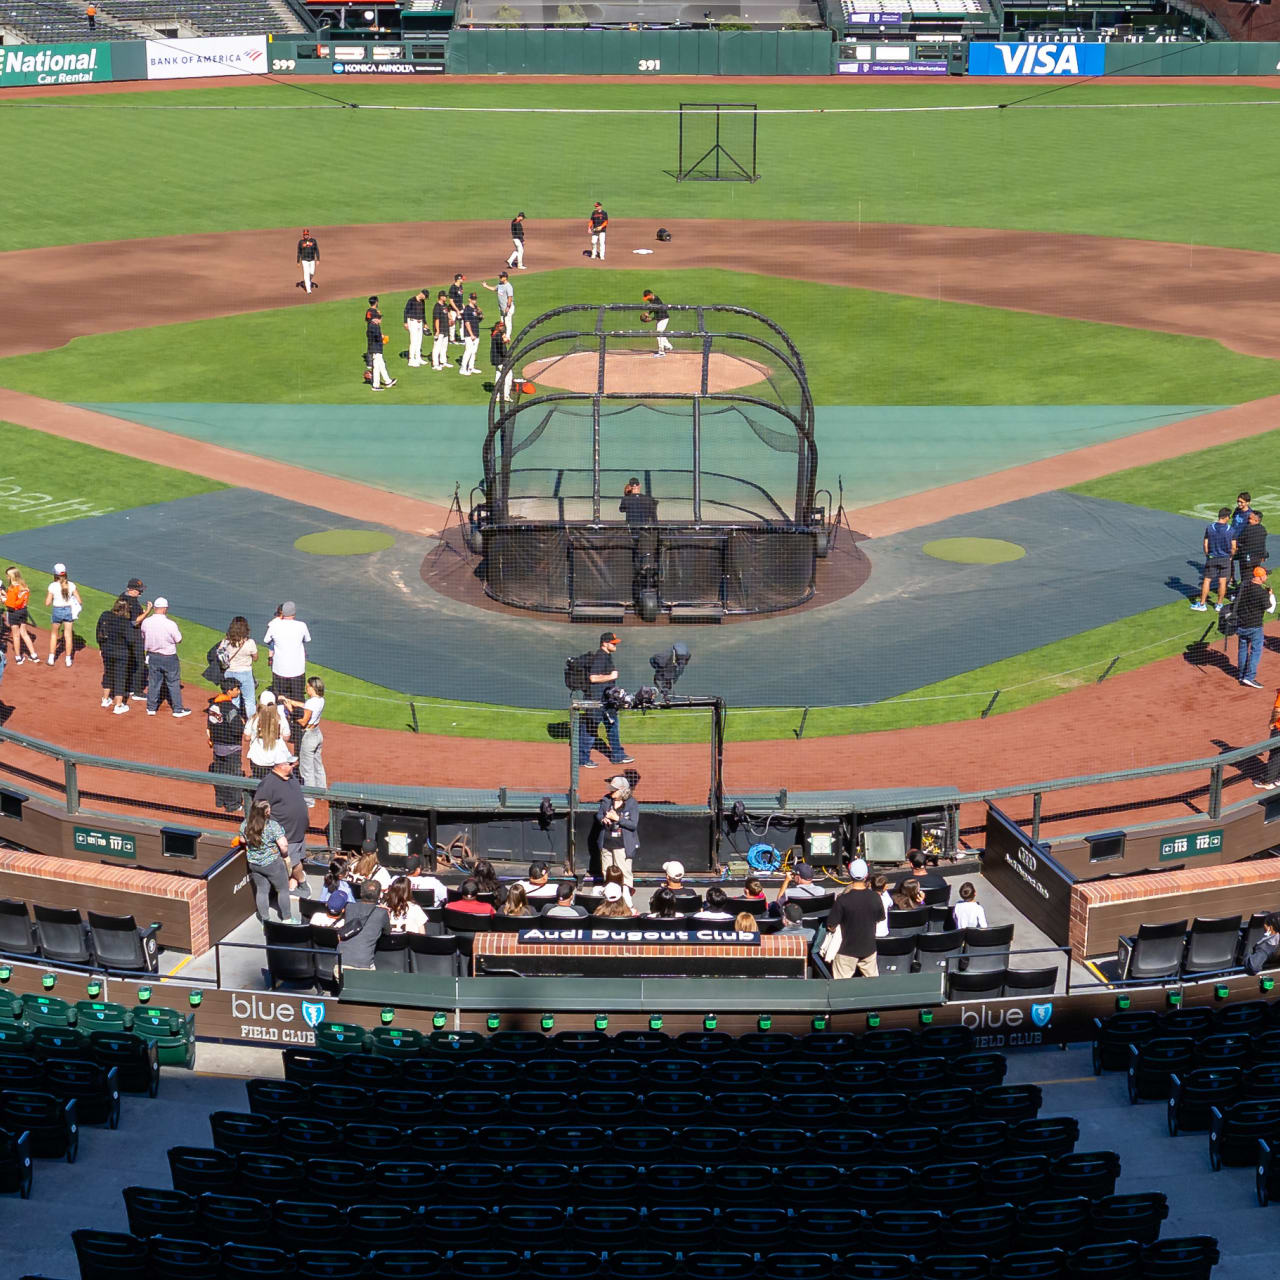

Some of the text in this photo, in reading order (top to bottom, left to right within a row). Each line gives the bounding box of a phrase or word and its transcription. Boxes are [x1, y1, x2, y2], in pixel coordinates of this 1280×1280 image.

[5, 48, 96, 73] National
[150, 54, 242, 66] BANK OF AMERICA
[272, 59, 296, 70] 399
[638, 59, 661, 72] 391
[994, 44, 1079, 74] VISA
[344, 64, 377, 73] KONICA
[378, 64, 415, 73] MINOLTA
[38, 71, 93, 85] Car Rental
[110, 838, 123, 850] 117
[1174, 838, 1210, 853] 113 112
[524, 928, 754, 942] Audi Dugout Club
[231, 993, 295, 1023] blue
[961, 1004, 1024, 1030] blue
[240, 1025, 316, 1044] FIELD CLUB
[970, 1034, 1005, 1048] IELD
